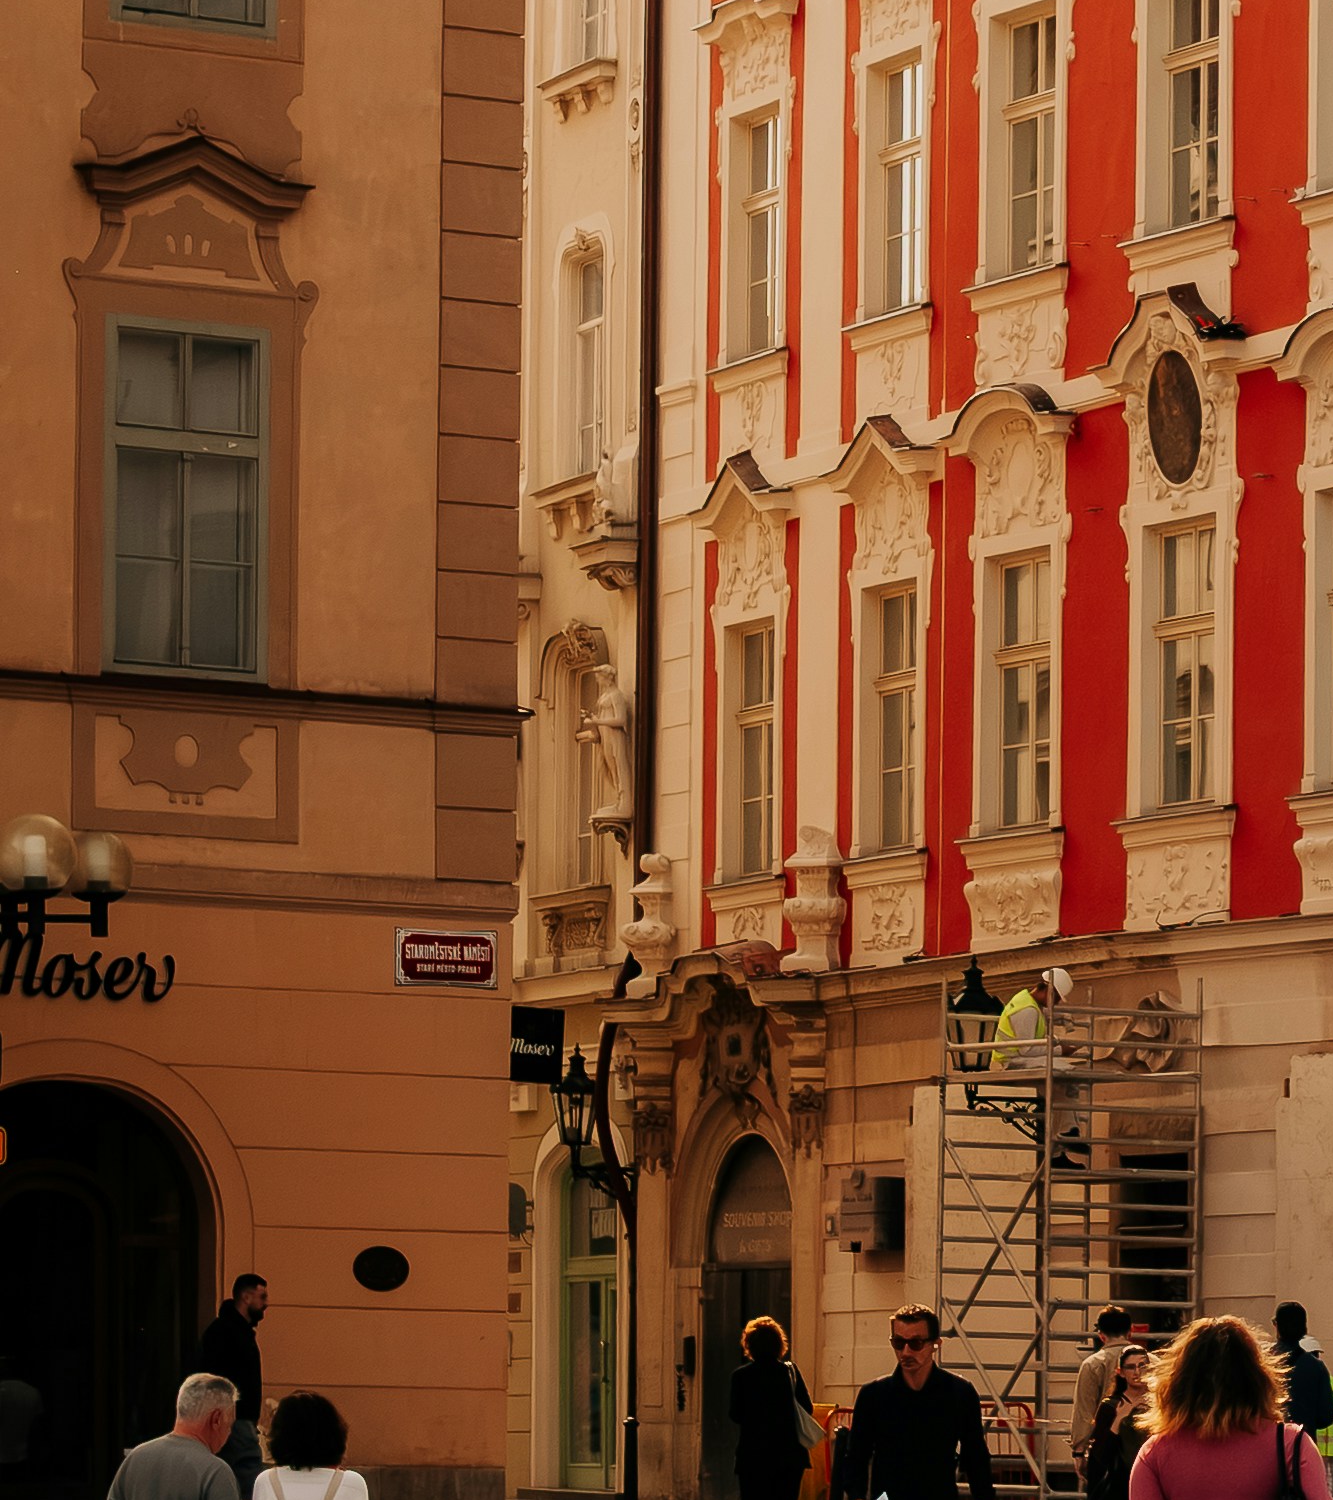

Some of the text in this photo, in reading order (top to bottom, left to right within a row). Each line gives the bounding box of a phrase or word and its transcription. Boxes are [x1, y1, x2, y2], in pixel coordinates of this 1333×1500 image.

[405, 941, 461, 961] STAROMĚSTSKÉ
[0, 931, 176, 1003] Moser
[510, 1037, 555, 1056] Moser
